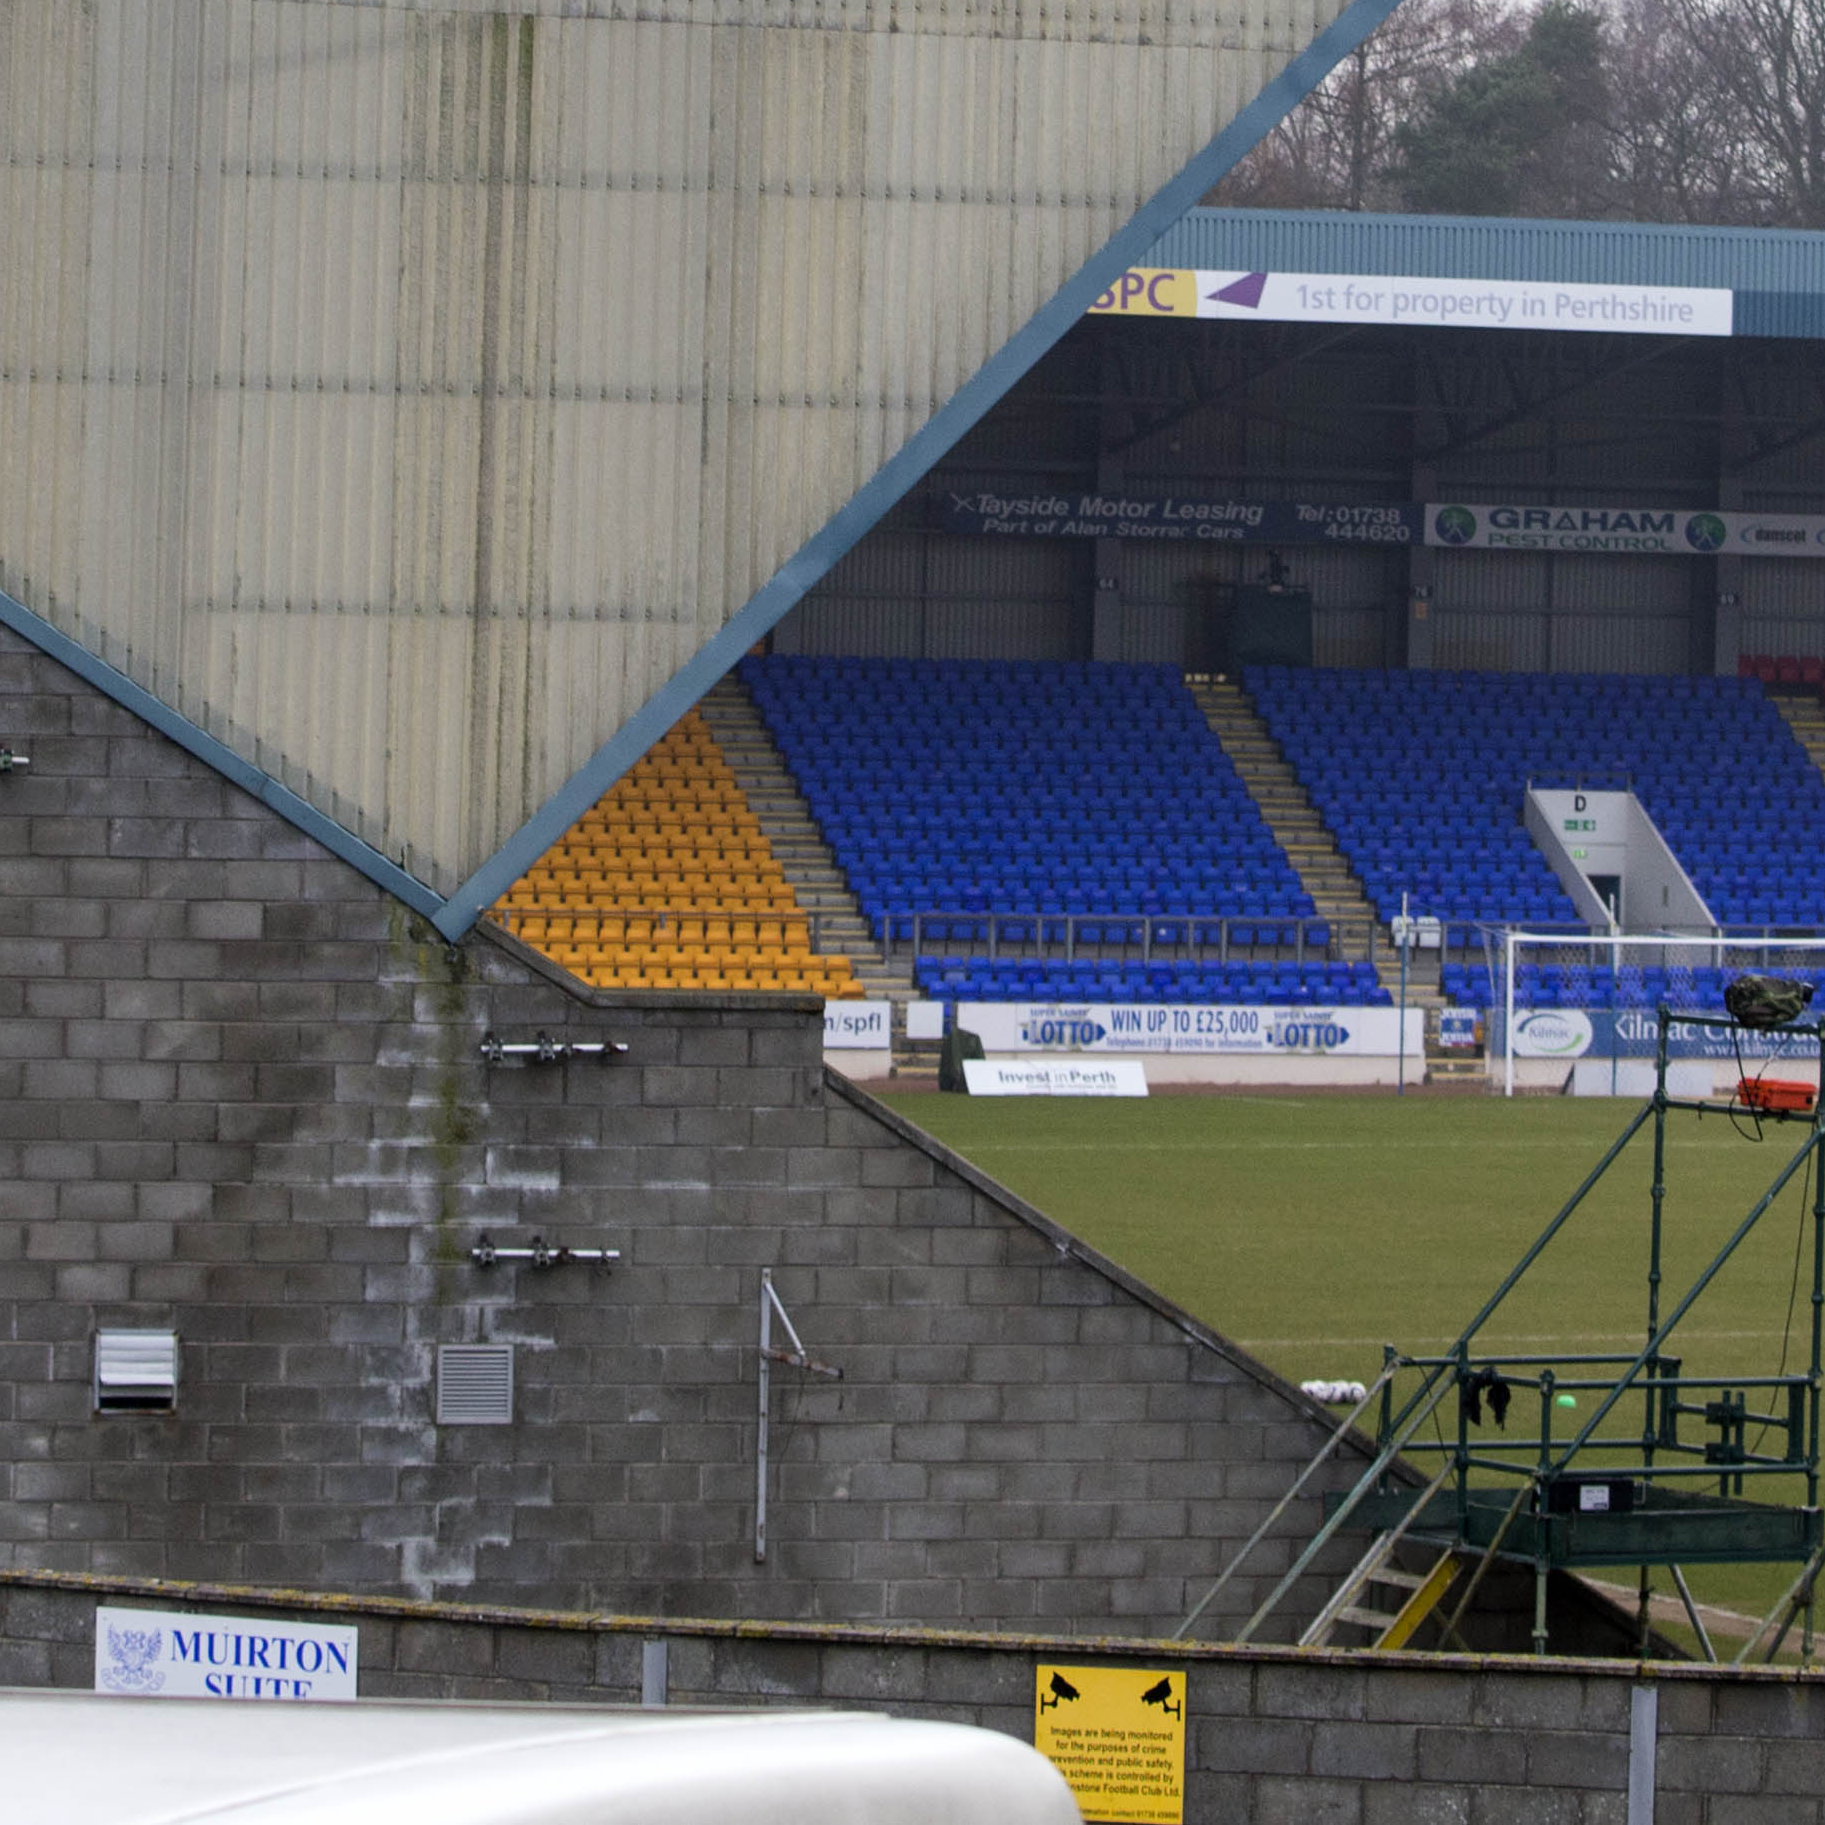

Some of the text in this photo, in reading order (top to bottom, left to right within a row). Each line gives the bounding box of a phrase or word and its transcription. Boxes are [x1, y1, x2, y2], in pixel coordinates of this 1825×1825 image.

[1296, 284, 1694, 324] 1st for property in Perthshire
[976, 493, 1070, 520] Tayside
[1078, 495, 1155, 518] Motor
[1162, 499, 1264, 526] Leasing
[983, 519, 1027, 534] Part
[1034, 520, 1057, 535] of
[1061, 521, 1108, 536] Alan
[1196, 523, 1245, 540] Cars
[1488, 507, 1675, 534] GRAHAM
[1324, 523, 1411, 542] 444620
[1487, 532, 1673, 551] PEST CONTROL
[1575, 794, 1587, 812] D
[1110, 1008, 1259, 1035] WIN UP TO £25,000
[1029, 1020, 1095, 1046] LOTTO
[1275, 1023, 1339, 1048] LOTTO
[998, 1069, 1117, 1083] Invest in Perth
[170, 1630, 350, 1675] MUIRTON
[1050, 1726, 1173, 1742] Images are being monitored
[1056, 1740, 1167, 1755] for the purposes of crime
[1097, 1756, 1114, 1766] and
[1116, 1756, 1143, 1768] public
[1069, 1768, 1103, 1779] scheme
[1105, 1769, 1113, 1779] is
[1116, 1770, 1161, 1782] controlled
[1163, 1772, 1174, 1785] by
[1103, 1783, 1139, 1794] Football
[1141, 1785, 1162, 1796] Club
